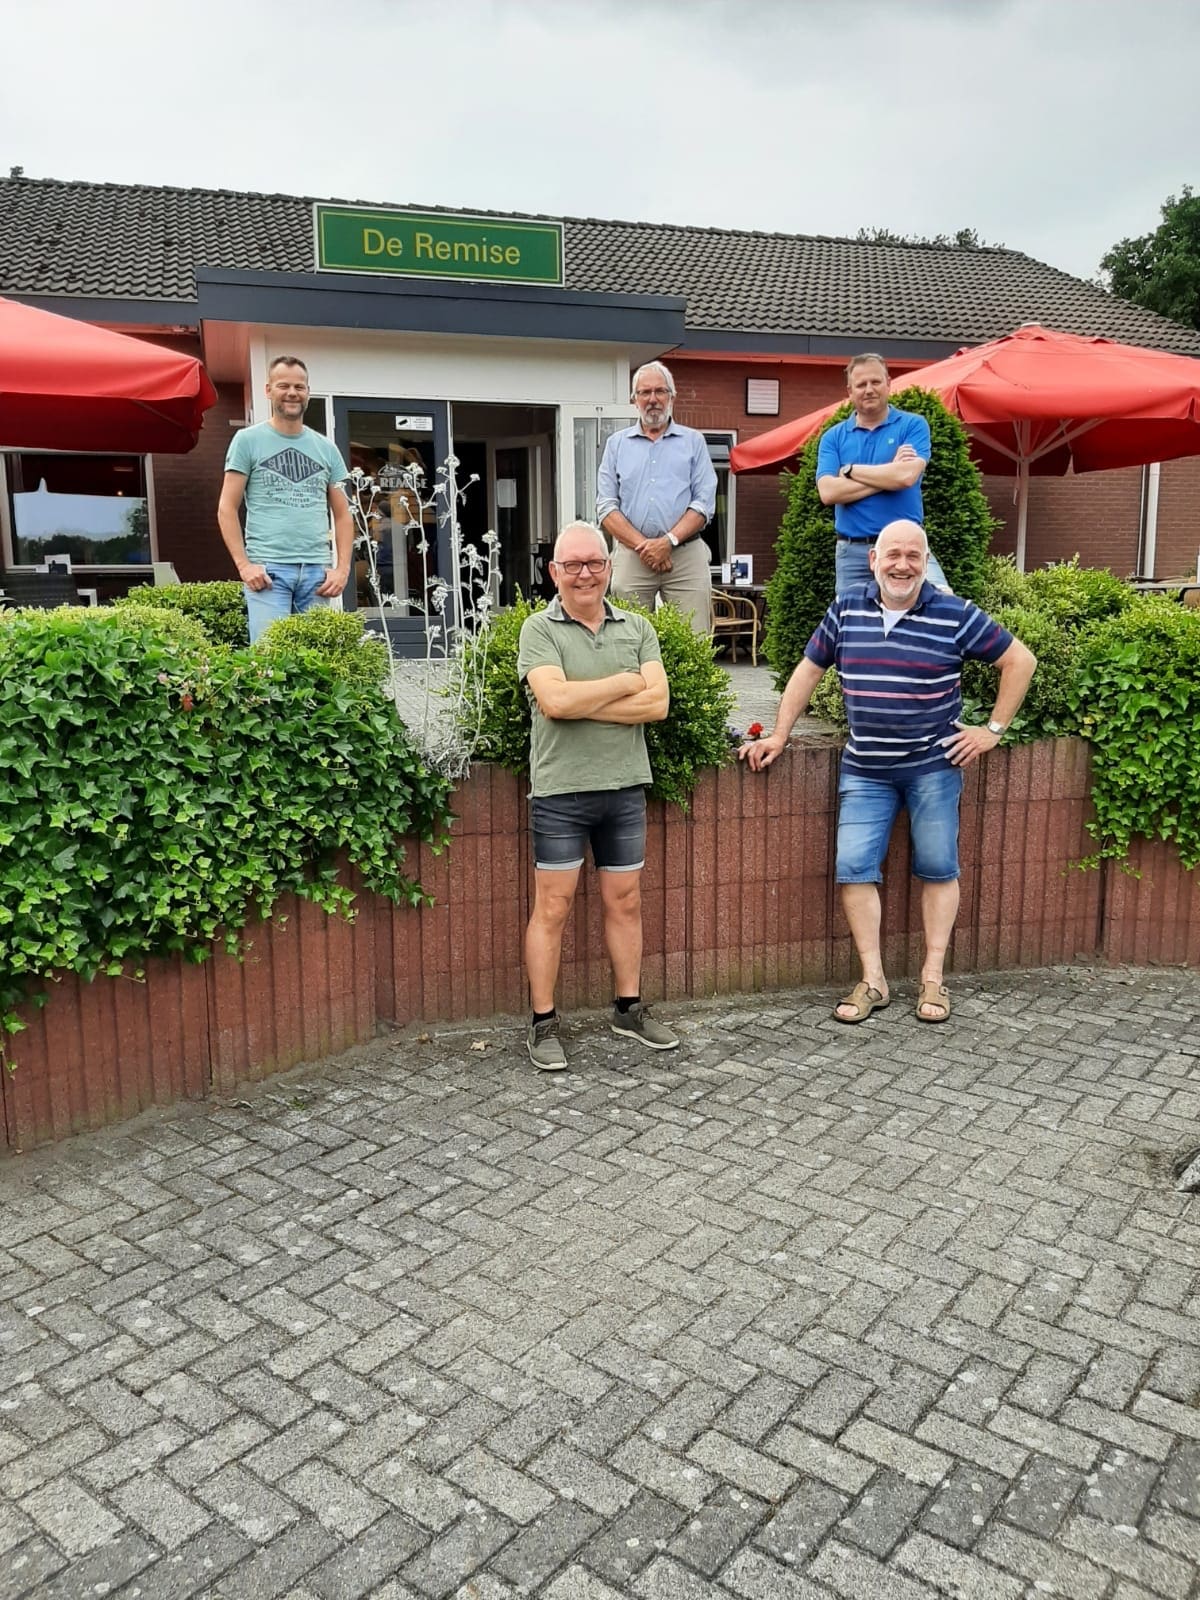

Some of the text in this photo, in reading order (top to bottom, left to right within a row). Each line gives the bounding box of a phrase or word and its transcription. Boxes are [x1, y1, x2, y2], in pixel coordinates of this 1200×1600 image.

[363, 228, 521, 265] De Remise
[380, 476, 429, 489] REMSE
